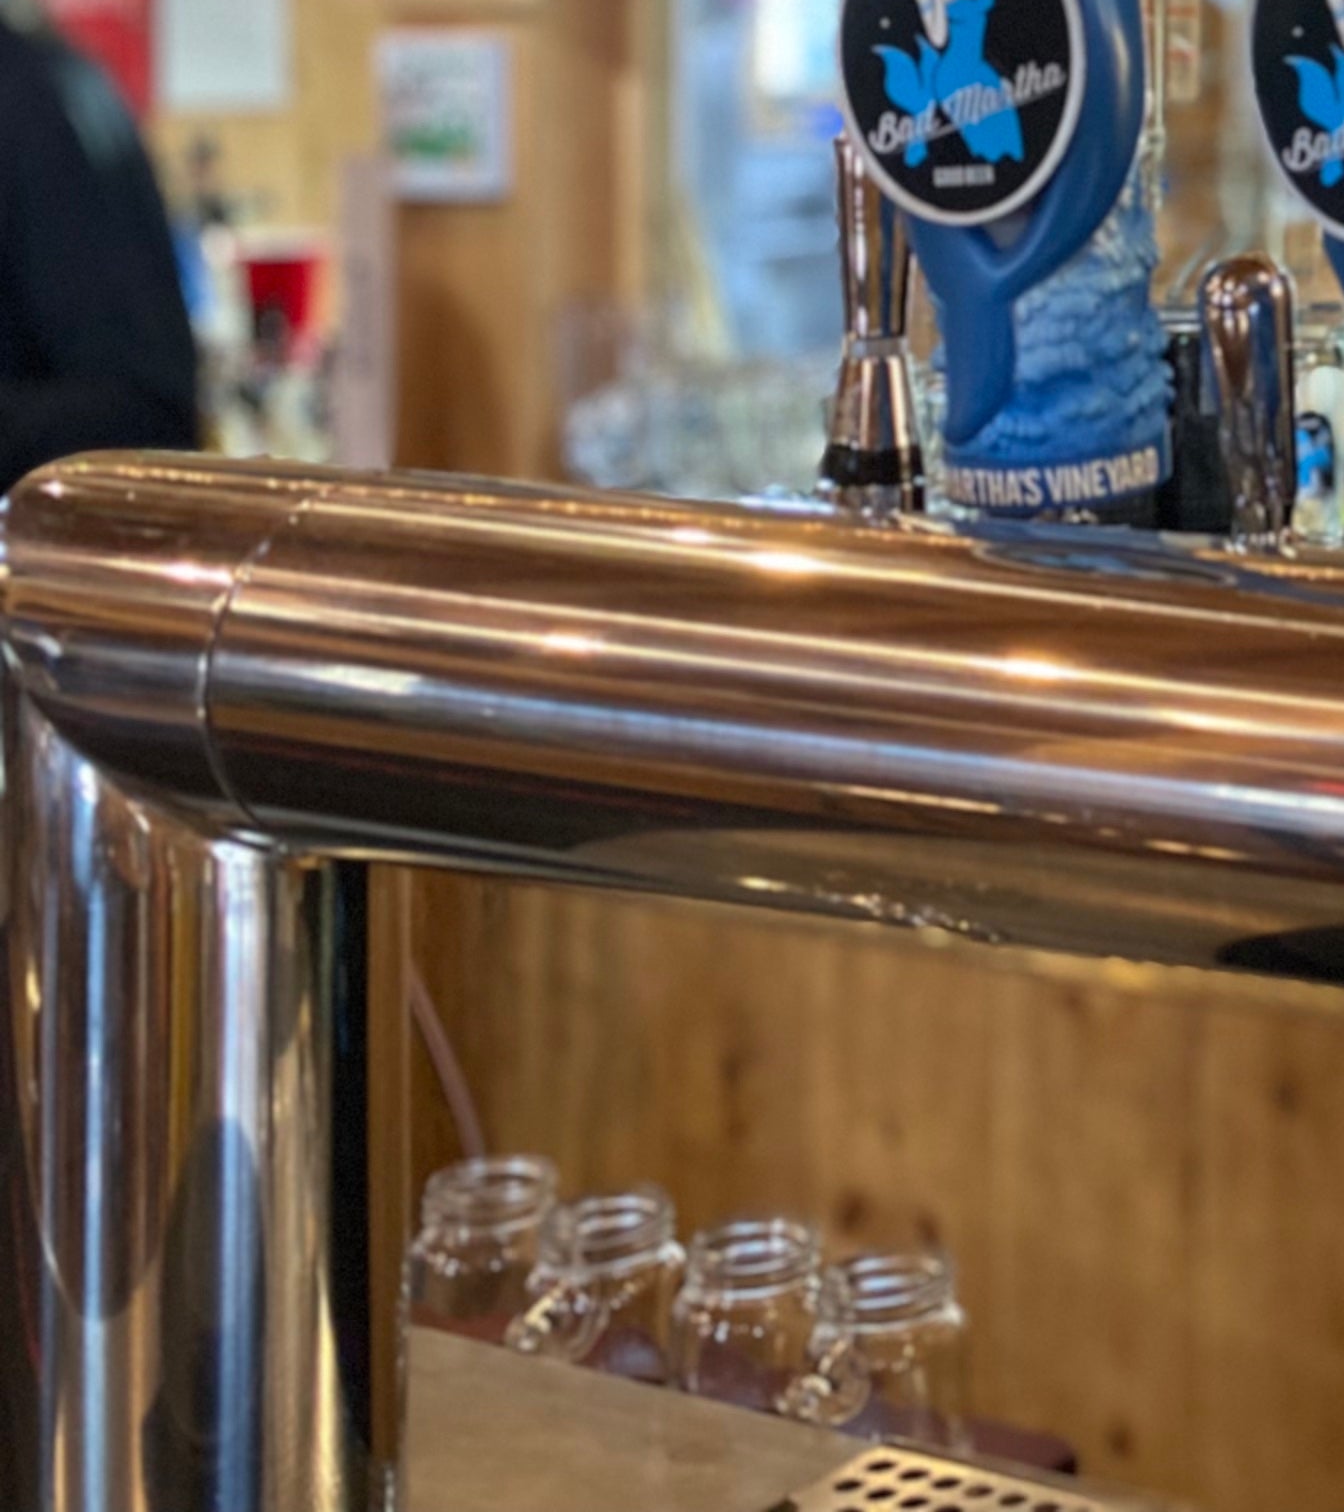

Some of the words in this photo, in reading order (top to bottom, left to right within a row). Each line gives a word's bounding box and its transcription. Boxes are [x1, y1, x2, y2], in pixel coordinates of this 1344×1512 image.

[868, 99, 945, 153] Bad
[940, 59, 1069, 128] Martha
[1045, 447, 1159, 505] VINEYARD
